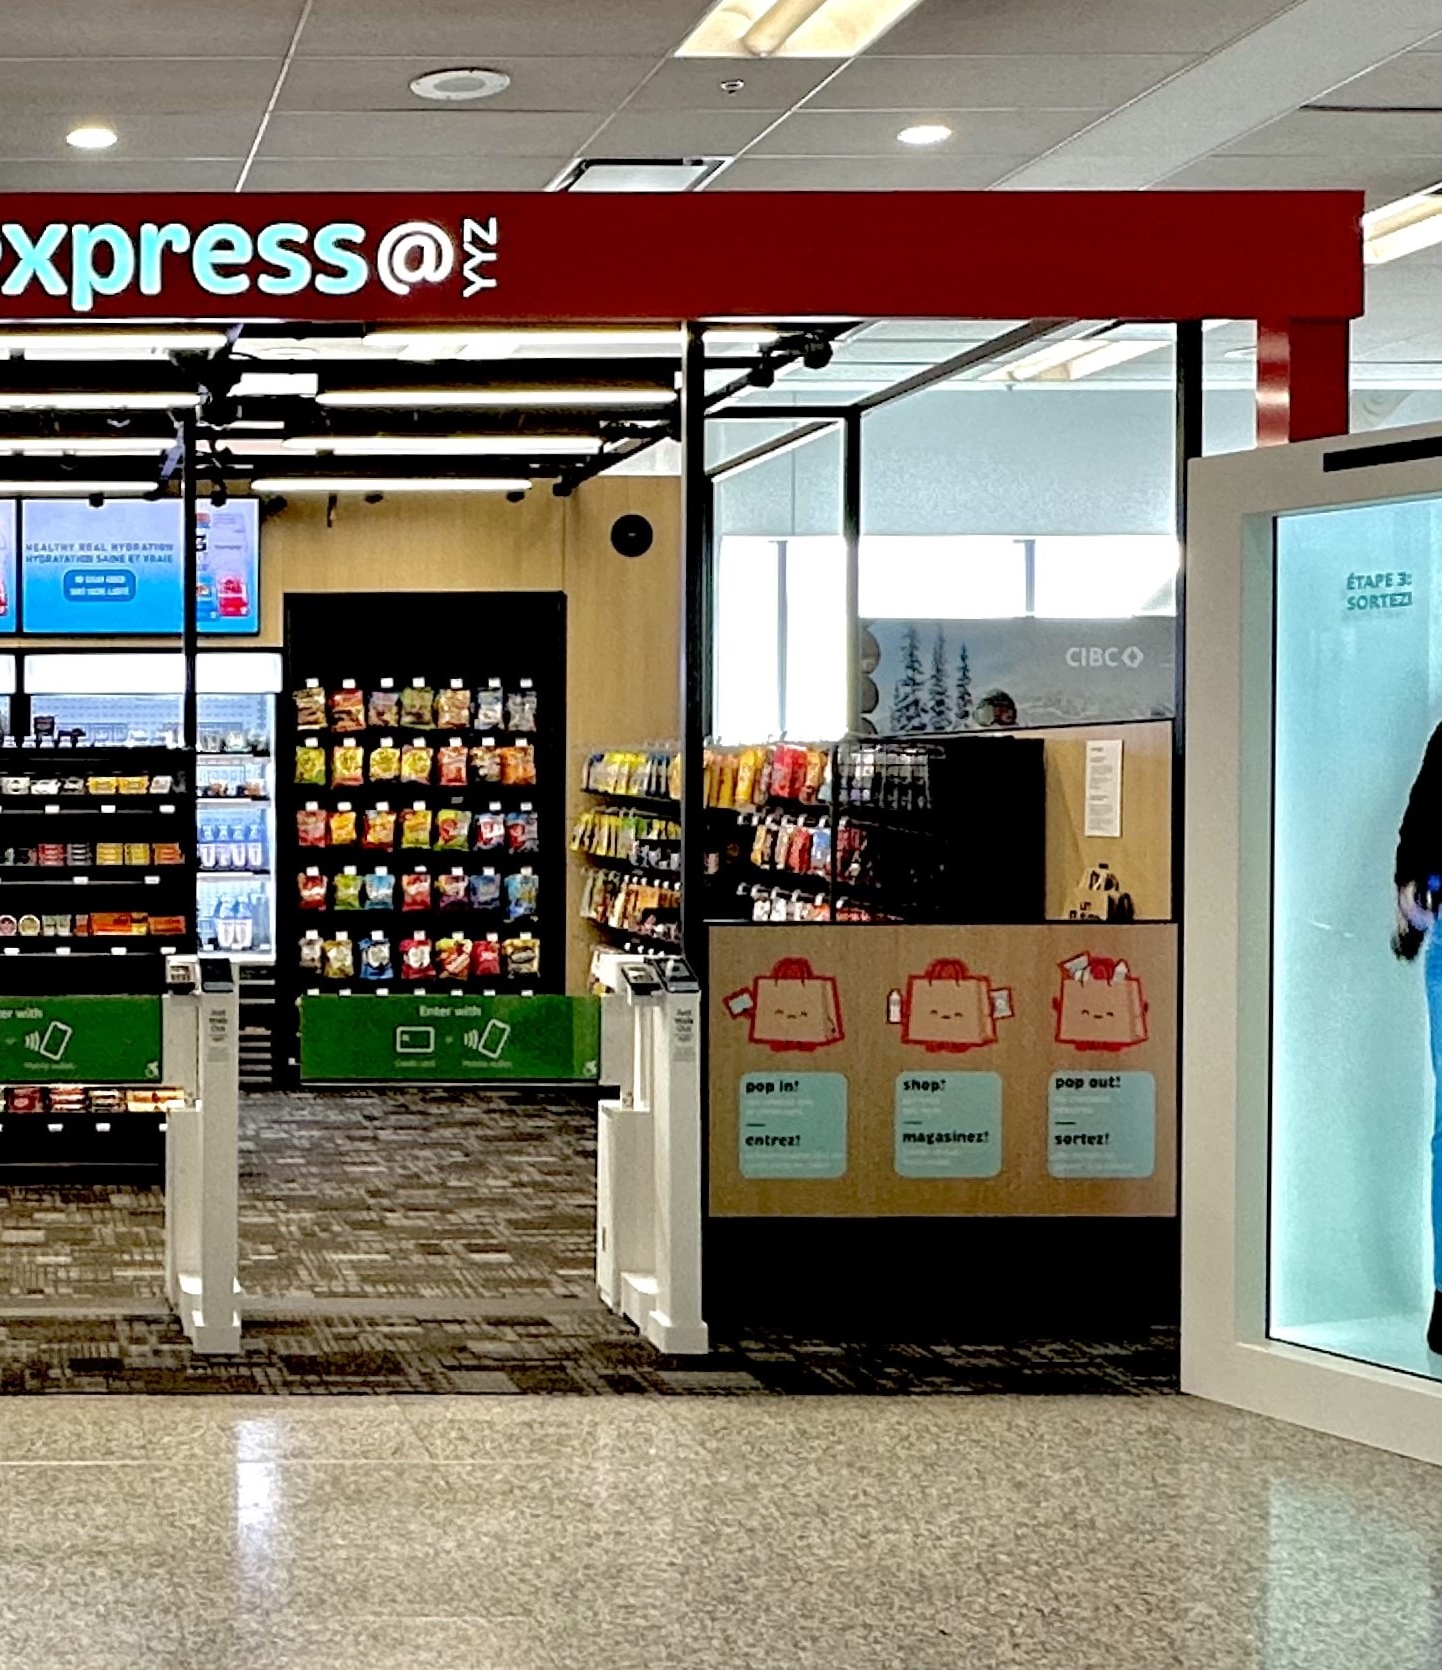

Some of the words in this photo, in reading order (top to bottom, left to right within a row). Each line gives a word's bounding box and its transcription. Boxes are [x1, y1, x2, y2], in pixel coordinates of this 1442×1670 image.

[462, 217, 499, 298] YYZ
[25, 543, 75, 552] HEALTHY
[78, 543, 107, 551] REAL
[111, 543, 174, 551] HYDRATION
[25, 555, 92, 563] HYDRATATION
[96, 555, 125, 563] SAINE
[128, 555, 140, 563] ET
[144, 555, 173, 563] VRAIE
[1346, 571, 1394, 590] ÉTAPE
[1397, 571, 1413, 587] 3:
[1065, 647, 1119, 667] CIBC
[15, 1007, 44, 1020] with
[419, 1004, 452, 1017] Enter
[454, 1004, 482, 1017] with
[745, 1081, 775, 1095] pop
[779, 1079, 800, 1094] in!
[903, 1078, 948, 1093] shop!
[1055, 1077, 1086, 1091] pop
[1089, 1075, 1122, 1089] out!
[745, 1134, 801, 1147] entrez!
[902, 1129, 990, 1146] magasinez!
[1054, 1133, 1110, 1147] sortez!
